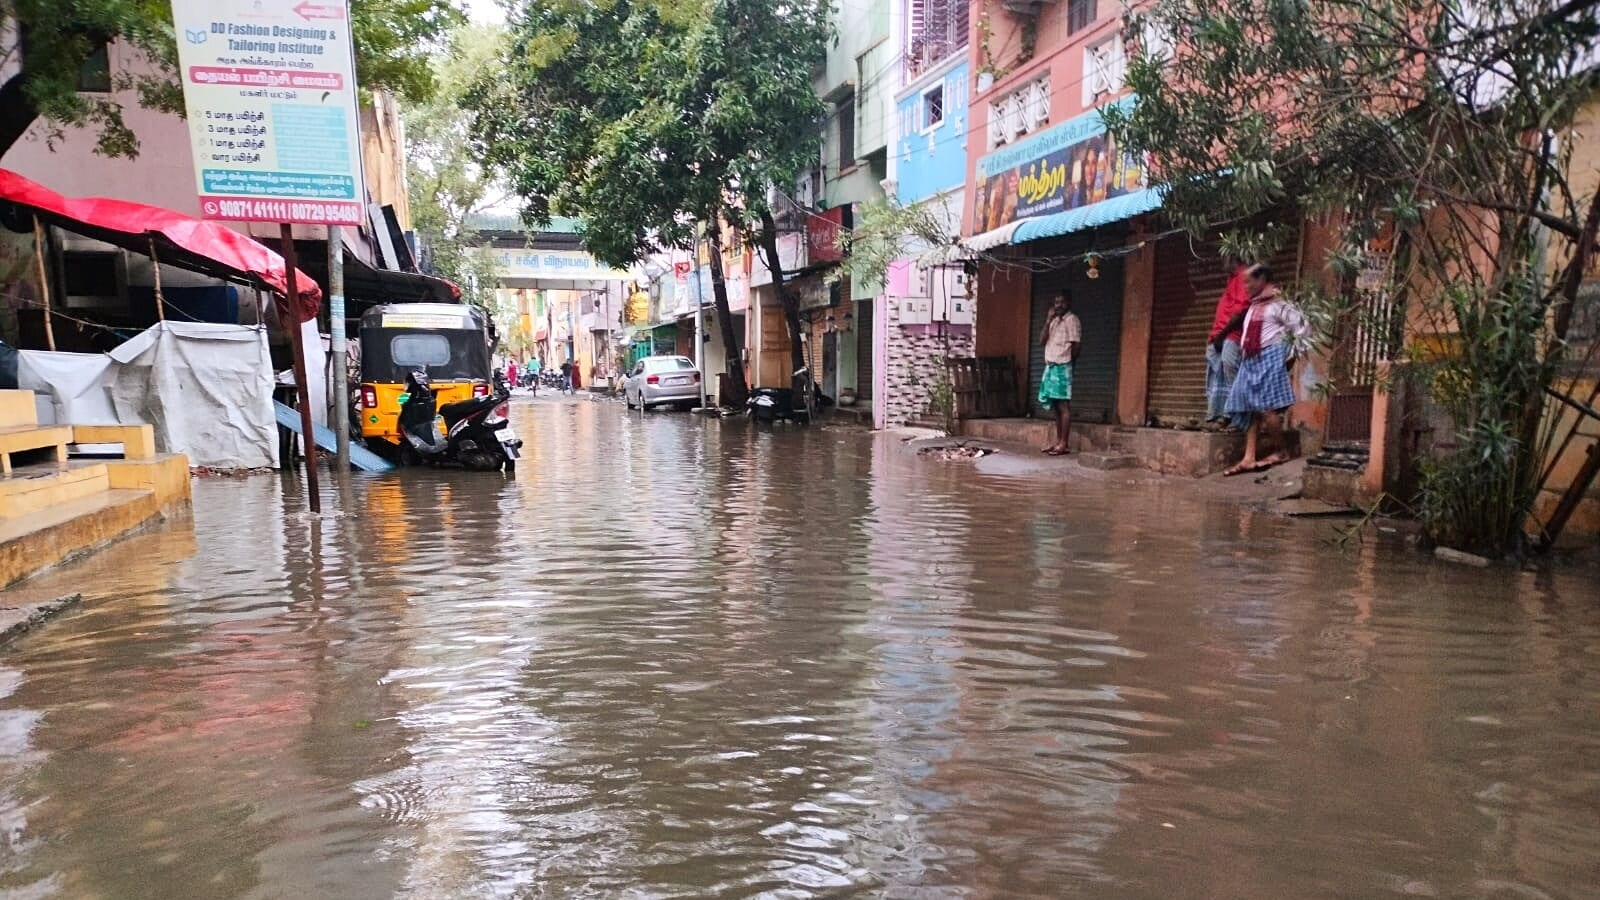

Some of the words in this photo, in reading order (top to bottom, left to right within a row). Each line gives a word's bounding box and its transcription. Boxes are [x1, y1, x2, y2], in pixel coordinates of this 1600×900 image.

[211, 22, 225, 34] DD
[228, 23, 270, 37] Fashion
[272, 25, 326, 41] Designing
[329, 30, 336, 40] &
[228, 39, 275, 54] Tailoring
[278, 42, 324, 55] Institute
[194, 68, 241, 83] தையல்
[243, 70, 291, 87] பயிற்சி
[292, 73, 339, 87] மையம்
[205, 110, 212, 119] 5
[214, 112, 233, 121] மாத
[236, 110, 264, 122] பயிற்சி
[208, 124, 214, 132] 3
[216, 126, 235, 135] மாத
[238, 124, 266, 136] பயிற்சி
[216, 140, 235, 149] மாத
[237, 138, 265, 150] பயிற்சி
[212, 154, 229, 163] வார
[232, 152, 260, 163] பயிற்சி
[1019, 159, 1065, 204] மந்த்ரா
[219, 200, 253, 216] 90871
[254, 202, 286, 219] 41111
[292, 203, 324, 220] 80729
